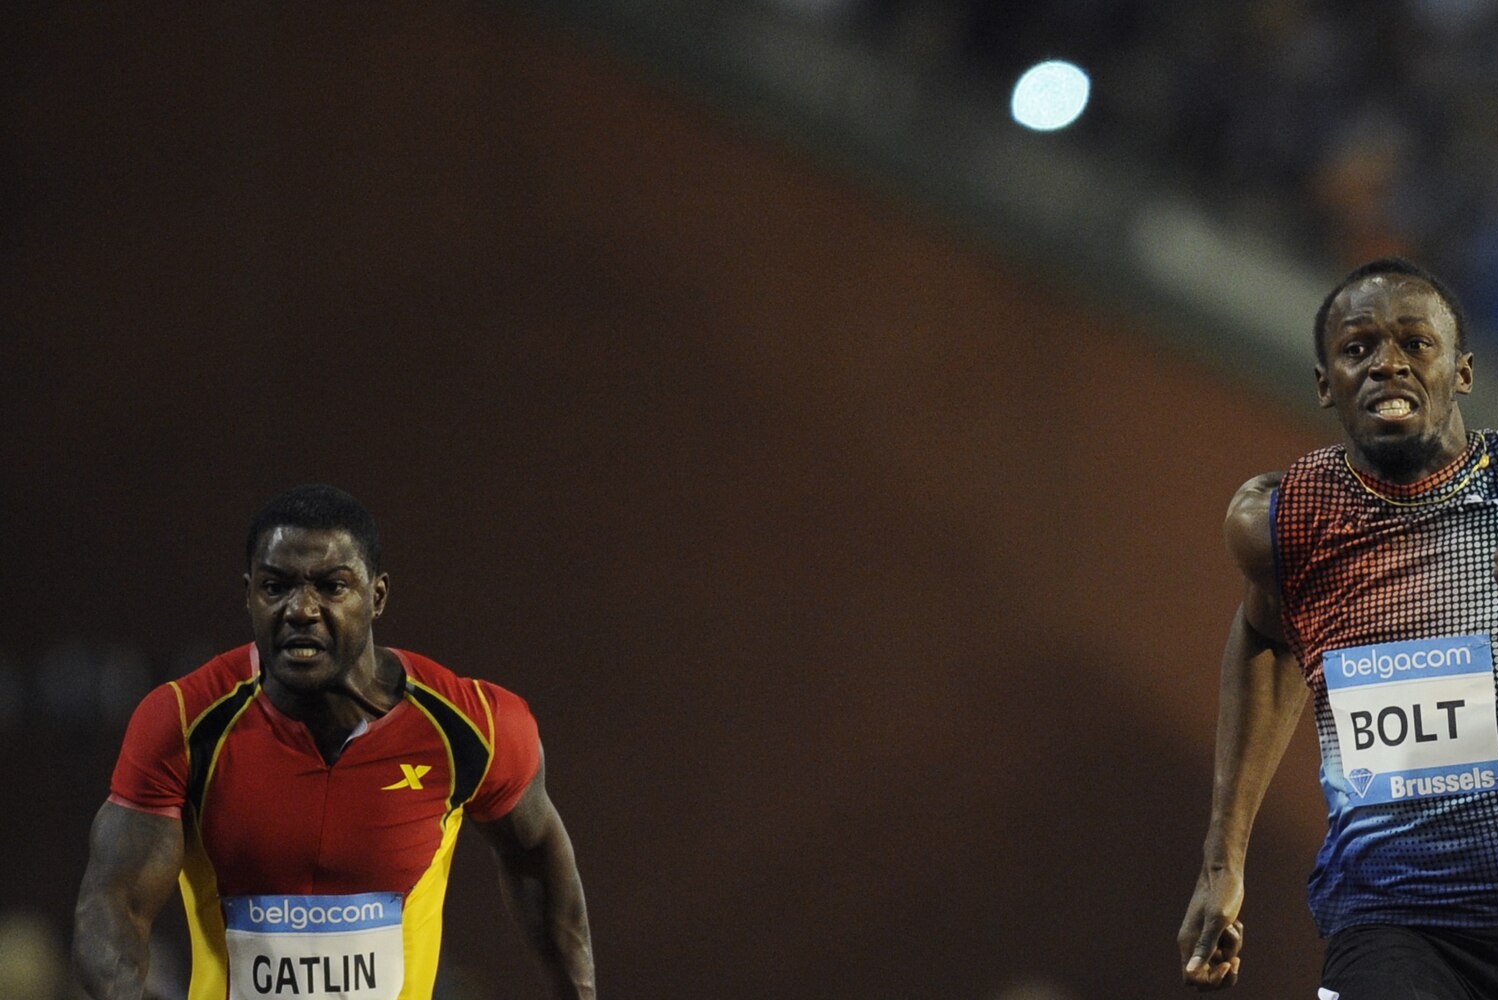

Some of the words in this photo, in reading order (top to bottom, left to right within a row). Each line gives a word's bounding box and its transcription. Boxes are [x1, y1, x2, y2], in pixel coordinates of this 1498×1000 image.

[1341, 646, 1472, 678] belgacom
[1350, 699, 1465, 750] BOLT
[1390, 767, 1495, 799] Brussels
[249, 898, 384, 930] belgacom
[252, 951, 377, 995] GATLIN
